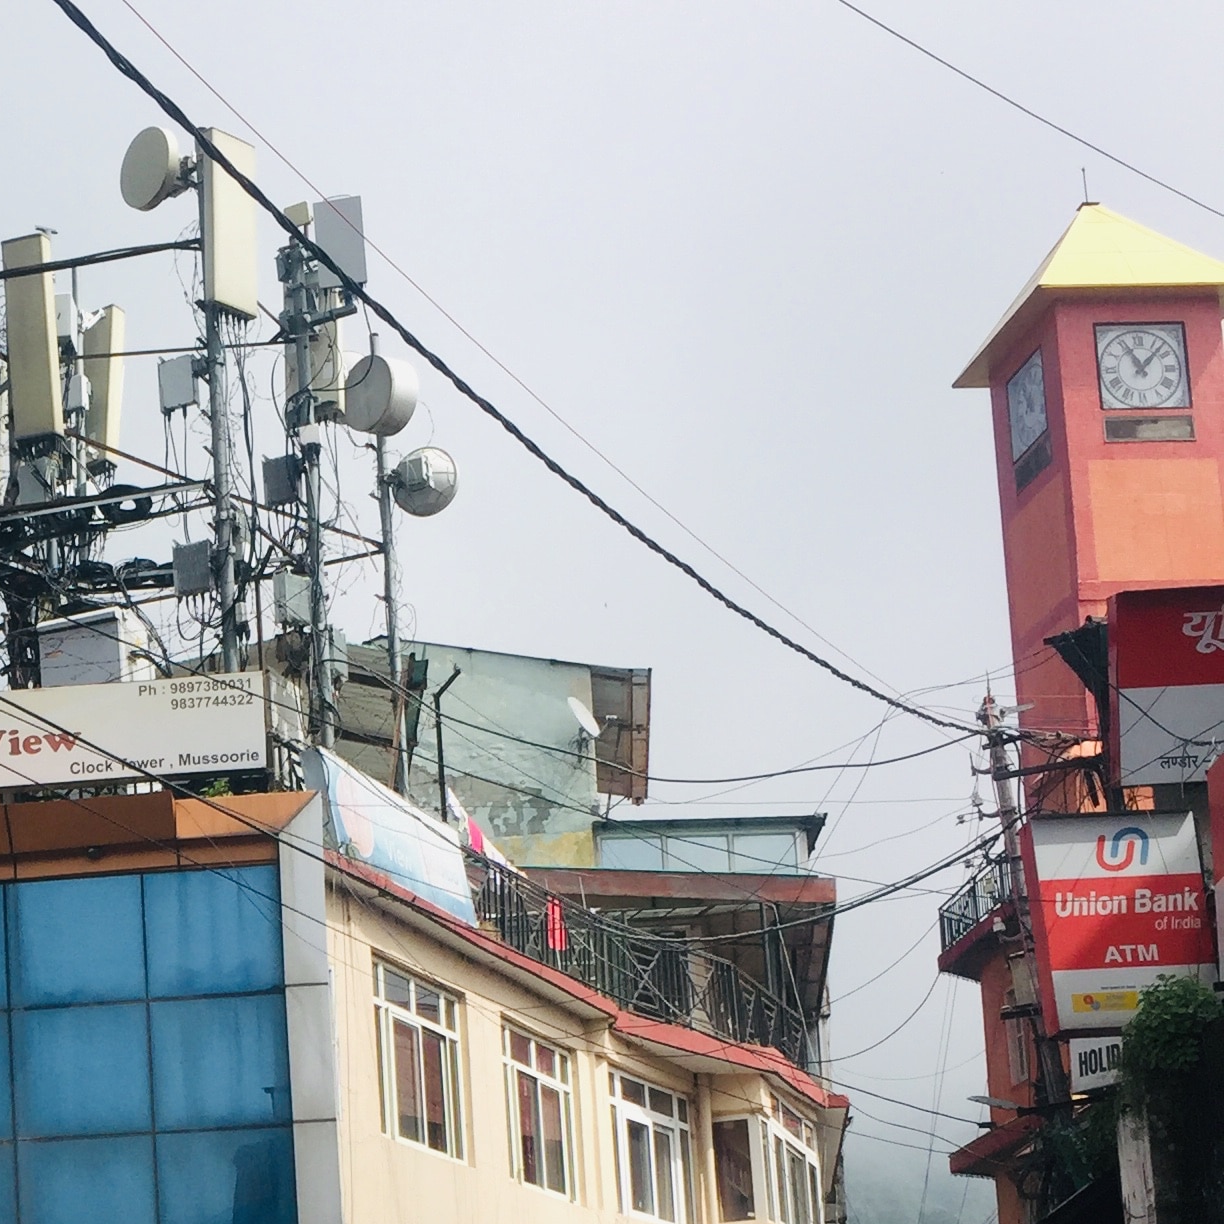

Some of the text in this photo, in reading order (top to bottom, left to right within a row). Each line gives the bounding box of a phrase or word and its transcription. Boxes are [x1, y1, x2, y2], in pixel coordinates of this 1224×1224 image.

[138, 684, 157, 697] Ph
[169, 678, 252, 695] 9897380031
[170, 694, 254, 710] 9837744322
[70, 758, 114, 776] Clock
[116, 755, 165, 772] Tower
[178, 748, 261, 767] Mussoorie
[1055, 885, 1199, 919] Union Bank
[1155, 915, 1202, 931] of India
[1104, 944, 1160, 965] ATM
[1078, 1044, 1120, 1078] HOLID
